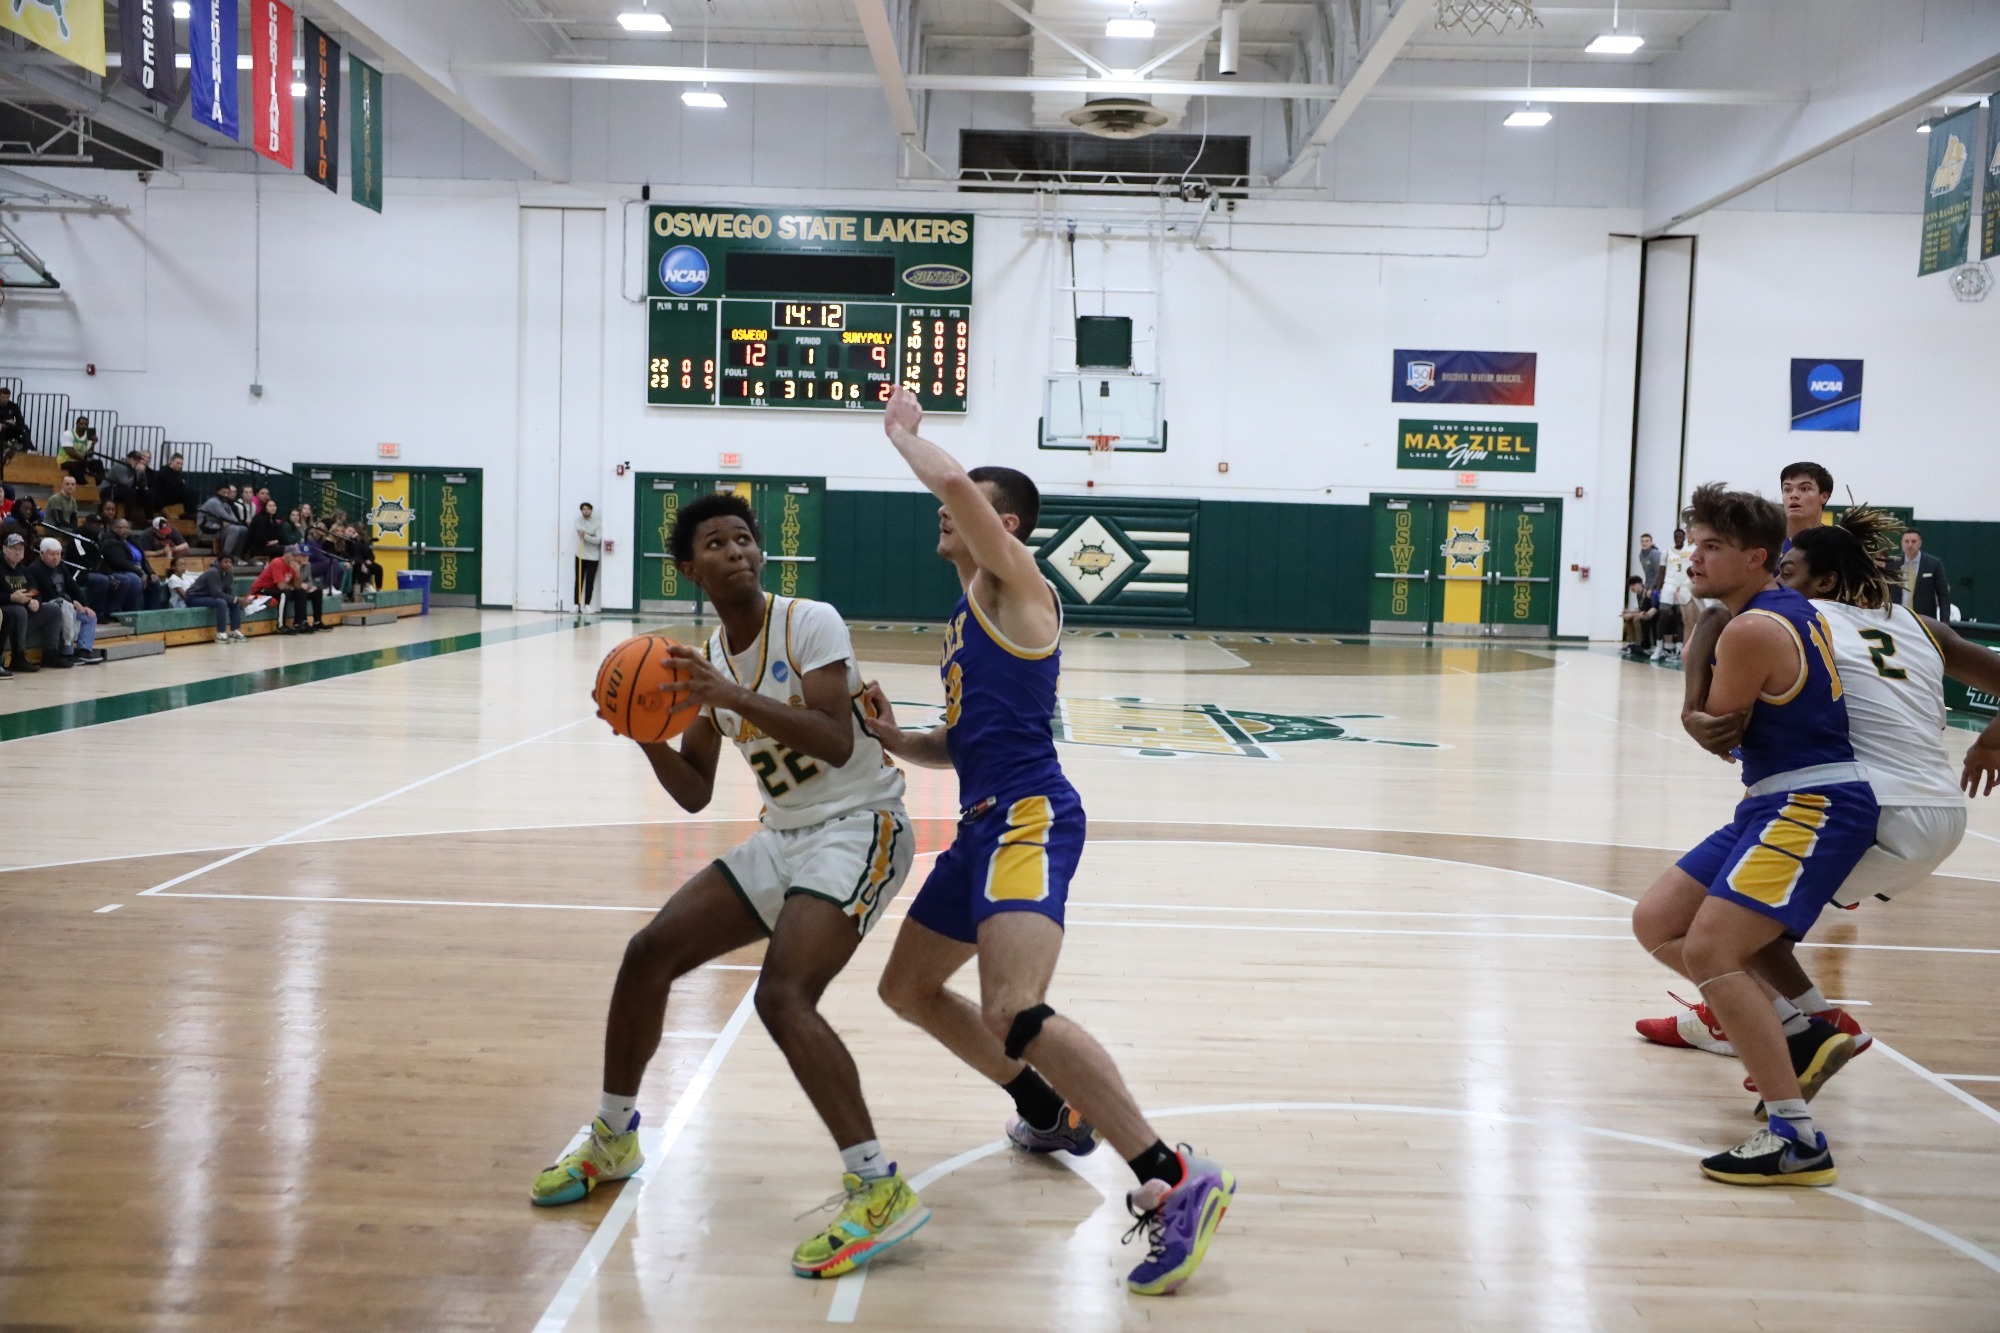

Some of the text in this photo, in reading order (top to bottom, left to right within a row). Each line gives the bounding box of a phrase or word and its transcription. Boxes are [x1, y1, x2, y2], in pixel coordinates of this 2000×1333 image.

[211, 0, 223, 124] EDONIA
[269, 1, 279, 152] CORTLAND
[318, 35, 328, 179] BUFFALO
[654, 212, 969, 244] OSWEGO STATE LAKERS
[664, 269, 708, 284] NCAA
[656, 302, 709, 311] PLYR FLS PTS
[909, 308, 961, 318] PLYR FLS PTS
[785, 304, 842, 328] 14:12
[731, 328, 768, 341] OSWEGO
[934, 320, 944, 335] 0
[956, 321, 967, 335] 0
[795, 337, 821, 345] PERIOD
[907, 335, 967, 350] 10 0 0
[745, 343, 766, 366] 12
[808, 348, 814, 365] 1
[871, 346, 886, 369] 9
[906, 351, 966, 365] 11 0 3
[650, 358, 714, 374] 22 0 0
[725, 368, 748, 377] FOULS
[775, 369, 838, 379] PLYR FOUL PTS
[906, 365, 965, 380] 12 1 0
[1413, 369, 1429, 379] 50
[650, 374, 713, 389] 23 0 5
[867, 372, 890, 381] FOULS
[742, 380, 765, 396] 1 6
[784, 380, 843, 400] 3 1 0
[849, 383, 891, 401] 6 2
[932, 381, 943, 395] 0
[955, 382, 965, 396] 2
[1809, 380, 1843, 392] NCAA
[750, 398, 769, 406] T.O.L.
[844, 400, 864, 409] T.O.L.
[1405, 433, 1531, 452] MAX ZIEL
[1446, 443, 1488, 469] Gym
[439, 486, 459, 589] LAKERS
[658, 493, 680, 596] OSGO
[781, 494, 800, 597] LAKERS
[1390, 511, 1414, 615] OSWEGO
[1513, 515, 1534, 619] LAKERS
[1858, 628, 1908, 680] 2
[750, 750, 819, 798] 22
